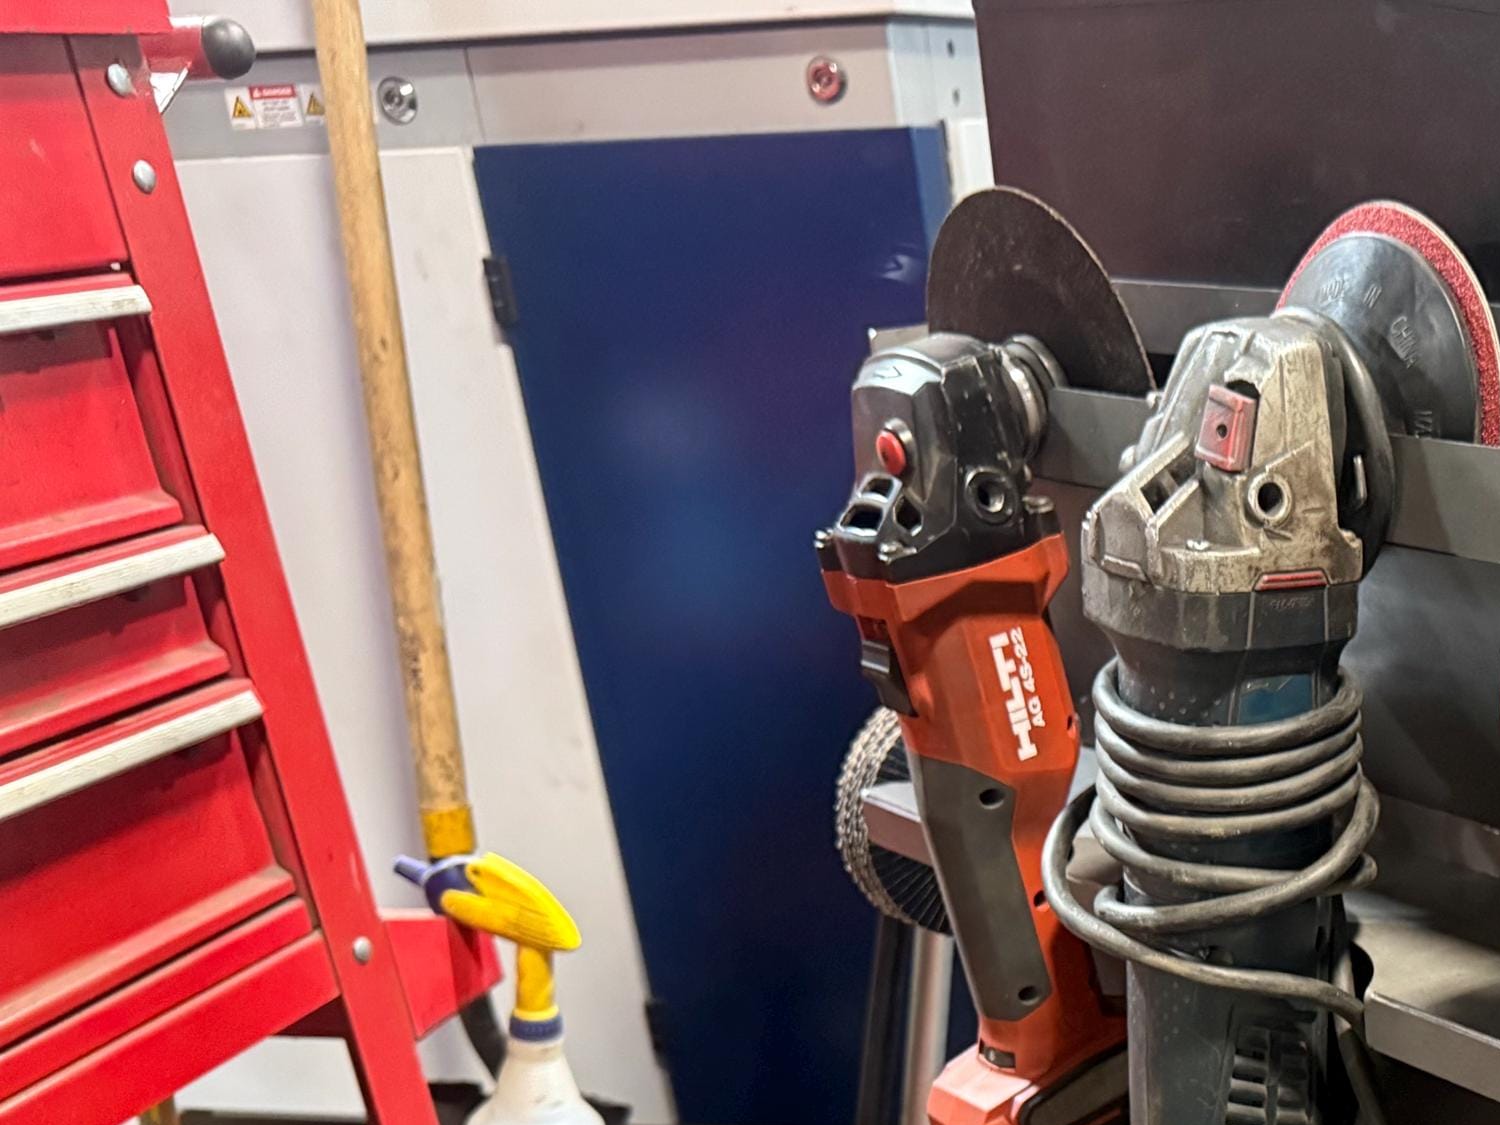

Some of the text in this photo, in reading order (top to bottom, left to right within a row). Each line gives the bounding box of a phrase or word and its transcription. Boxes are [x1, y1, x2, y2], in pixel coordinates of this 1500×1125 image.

[989, 632, 1038, 761] HILTI
[1010, 626, 1046, 728] AG 4S-22
